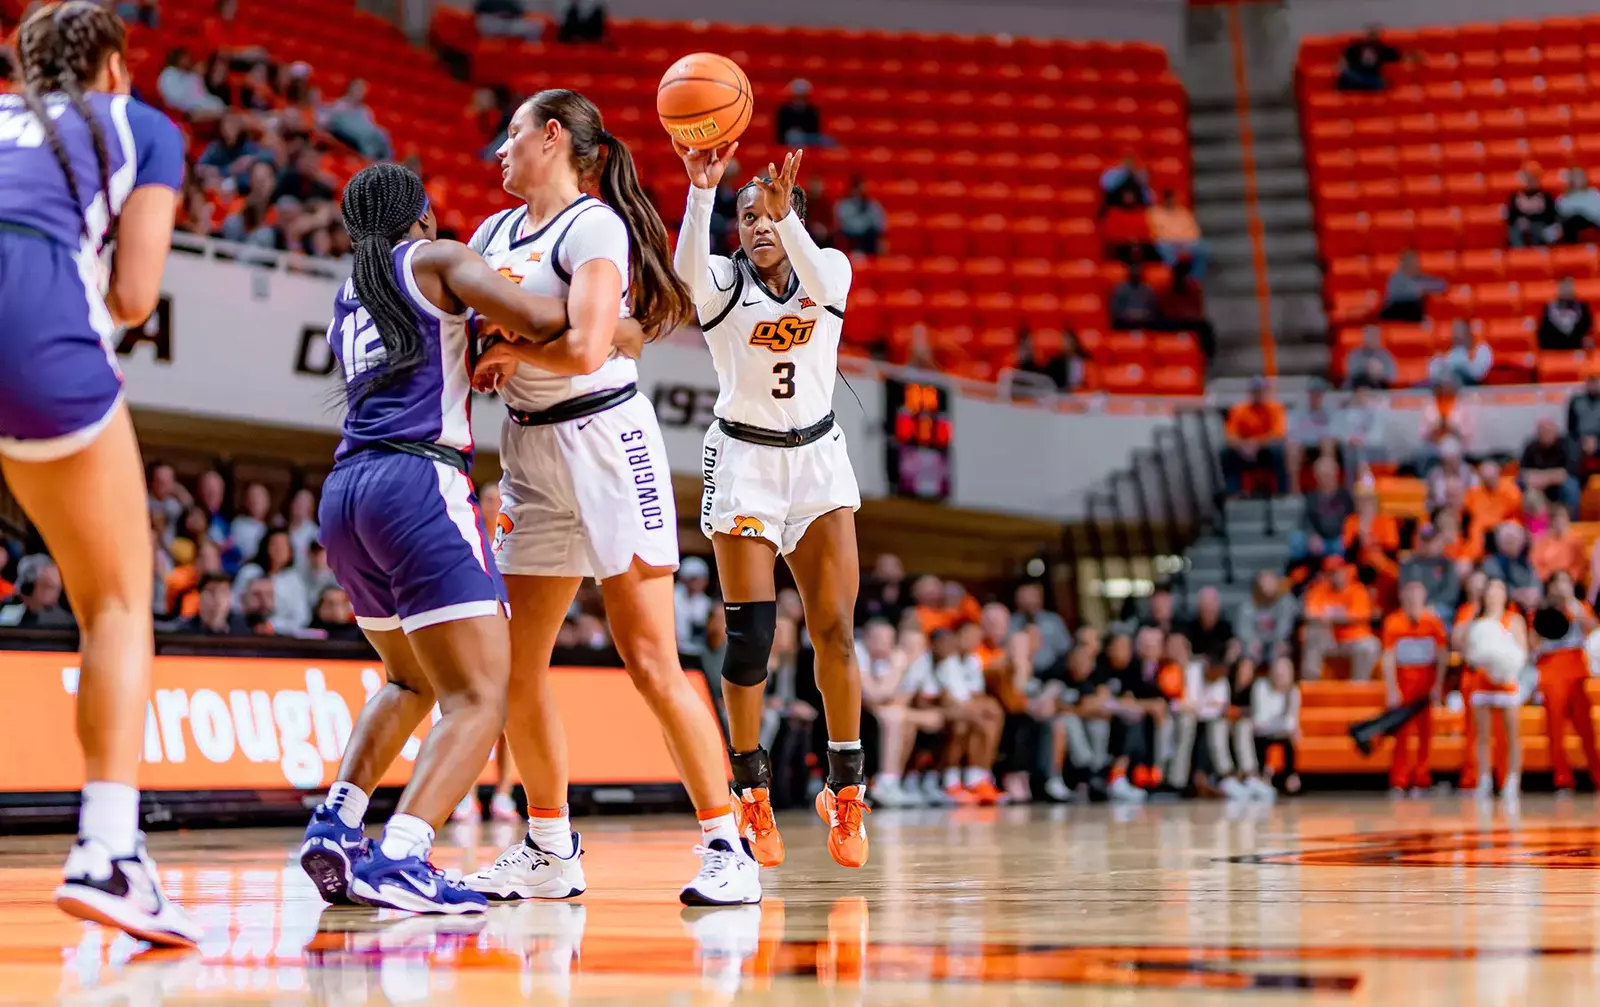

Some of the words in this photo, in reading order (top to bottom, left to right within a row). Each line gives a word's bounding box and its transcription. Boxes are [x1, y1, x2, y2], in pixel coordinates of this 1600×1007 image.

[340, 305, 388, 383] 12
[748, 315, 817, 353] OSU
[771, 361, 796, 399] 3
[620, 429, 664, 531] COWGIRLS
